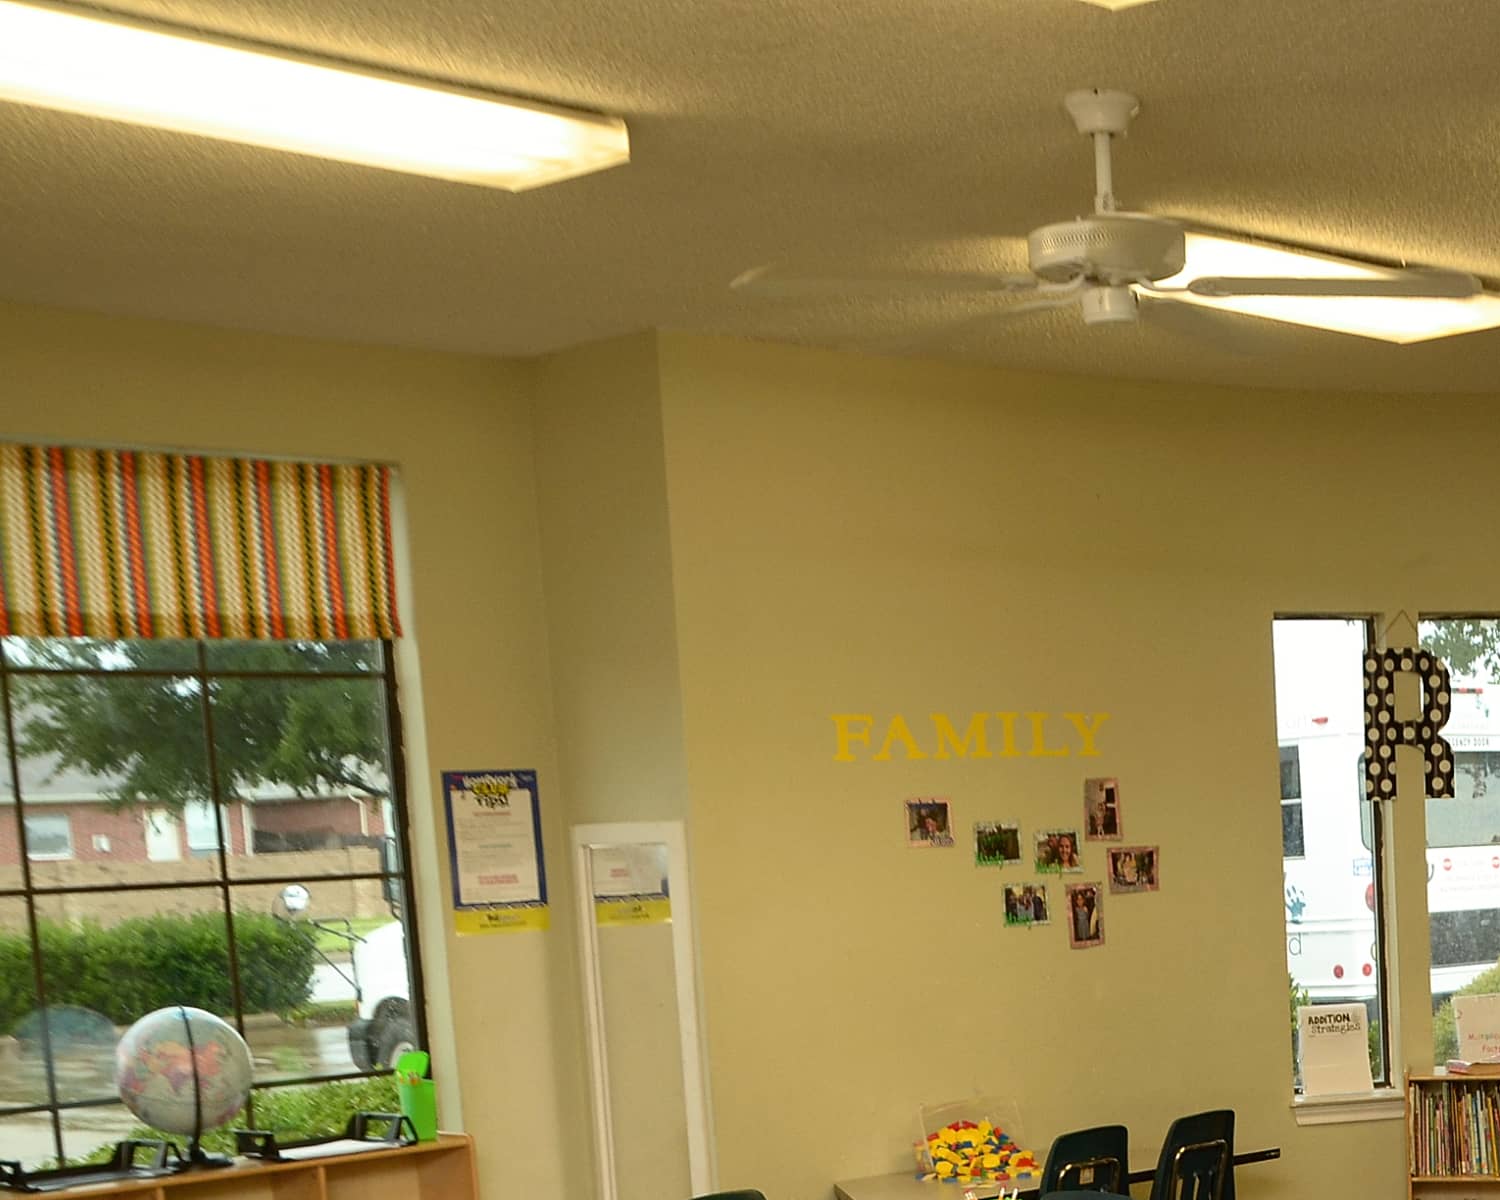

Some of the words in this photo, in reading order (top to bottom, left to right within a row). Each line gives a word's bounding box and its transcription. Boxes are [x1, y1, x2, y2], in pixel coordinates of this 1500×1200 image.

[829, 711, 1111, 762] FAMILY
[1308, 1013, 1350, 1025] ADDITION
[1311, 1022, 1361, 1035] Strategies
